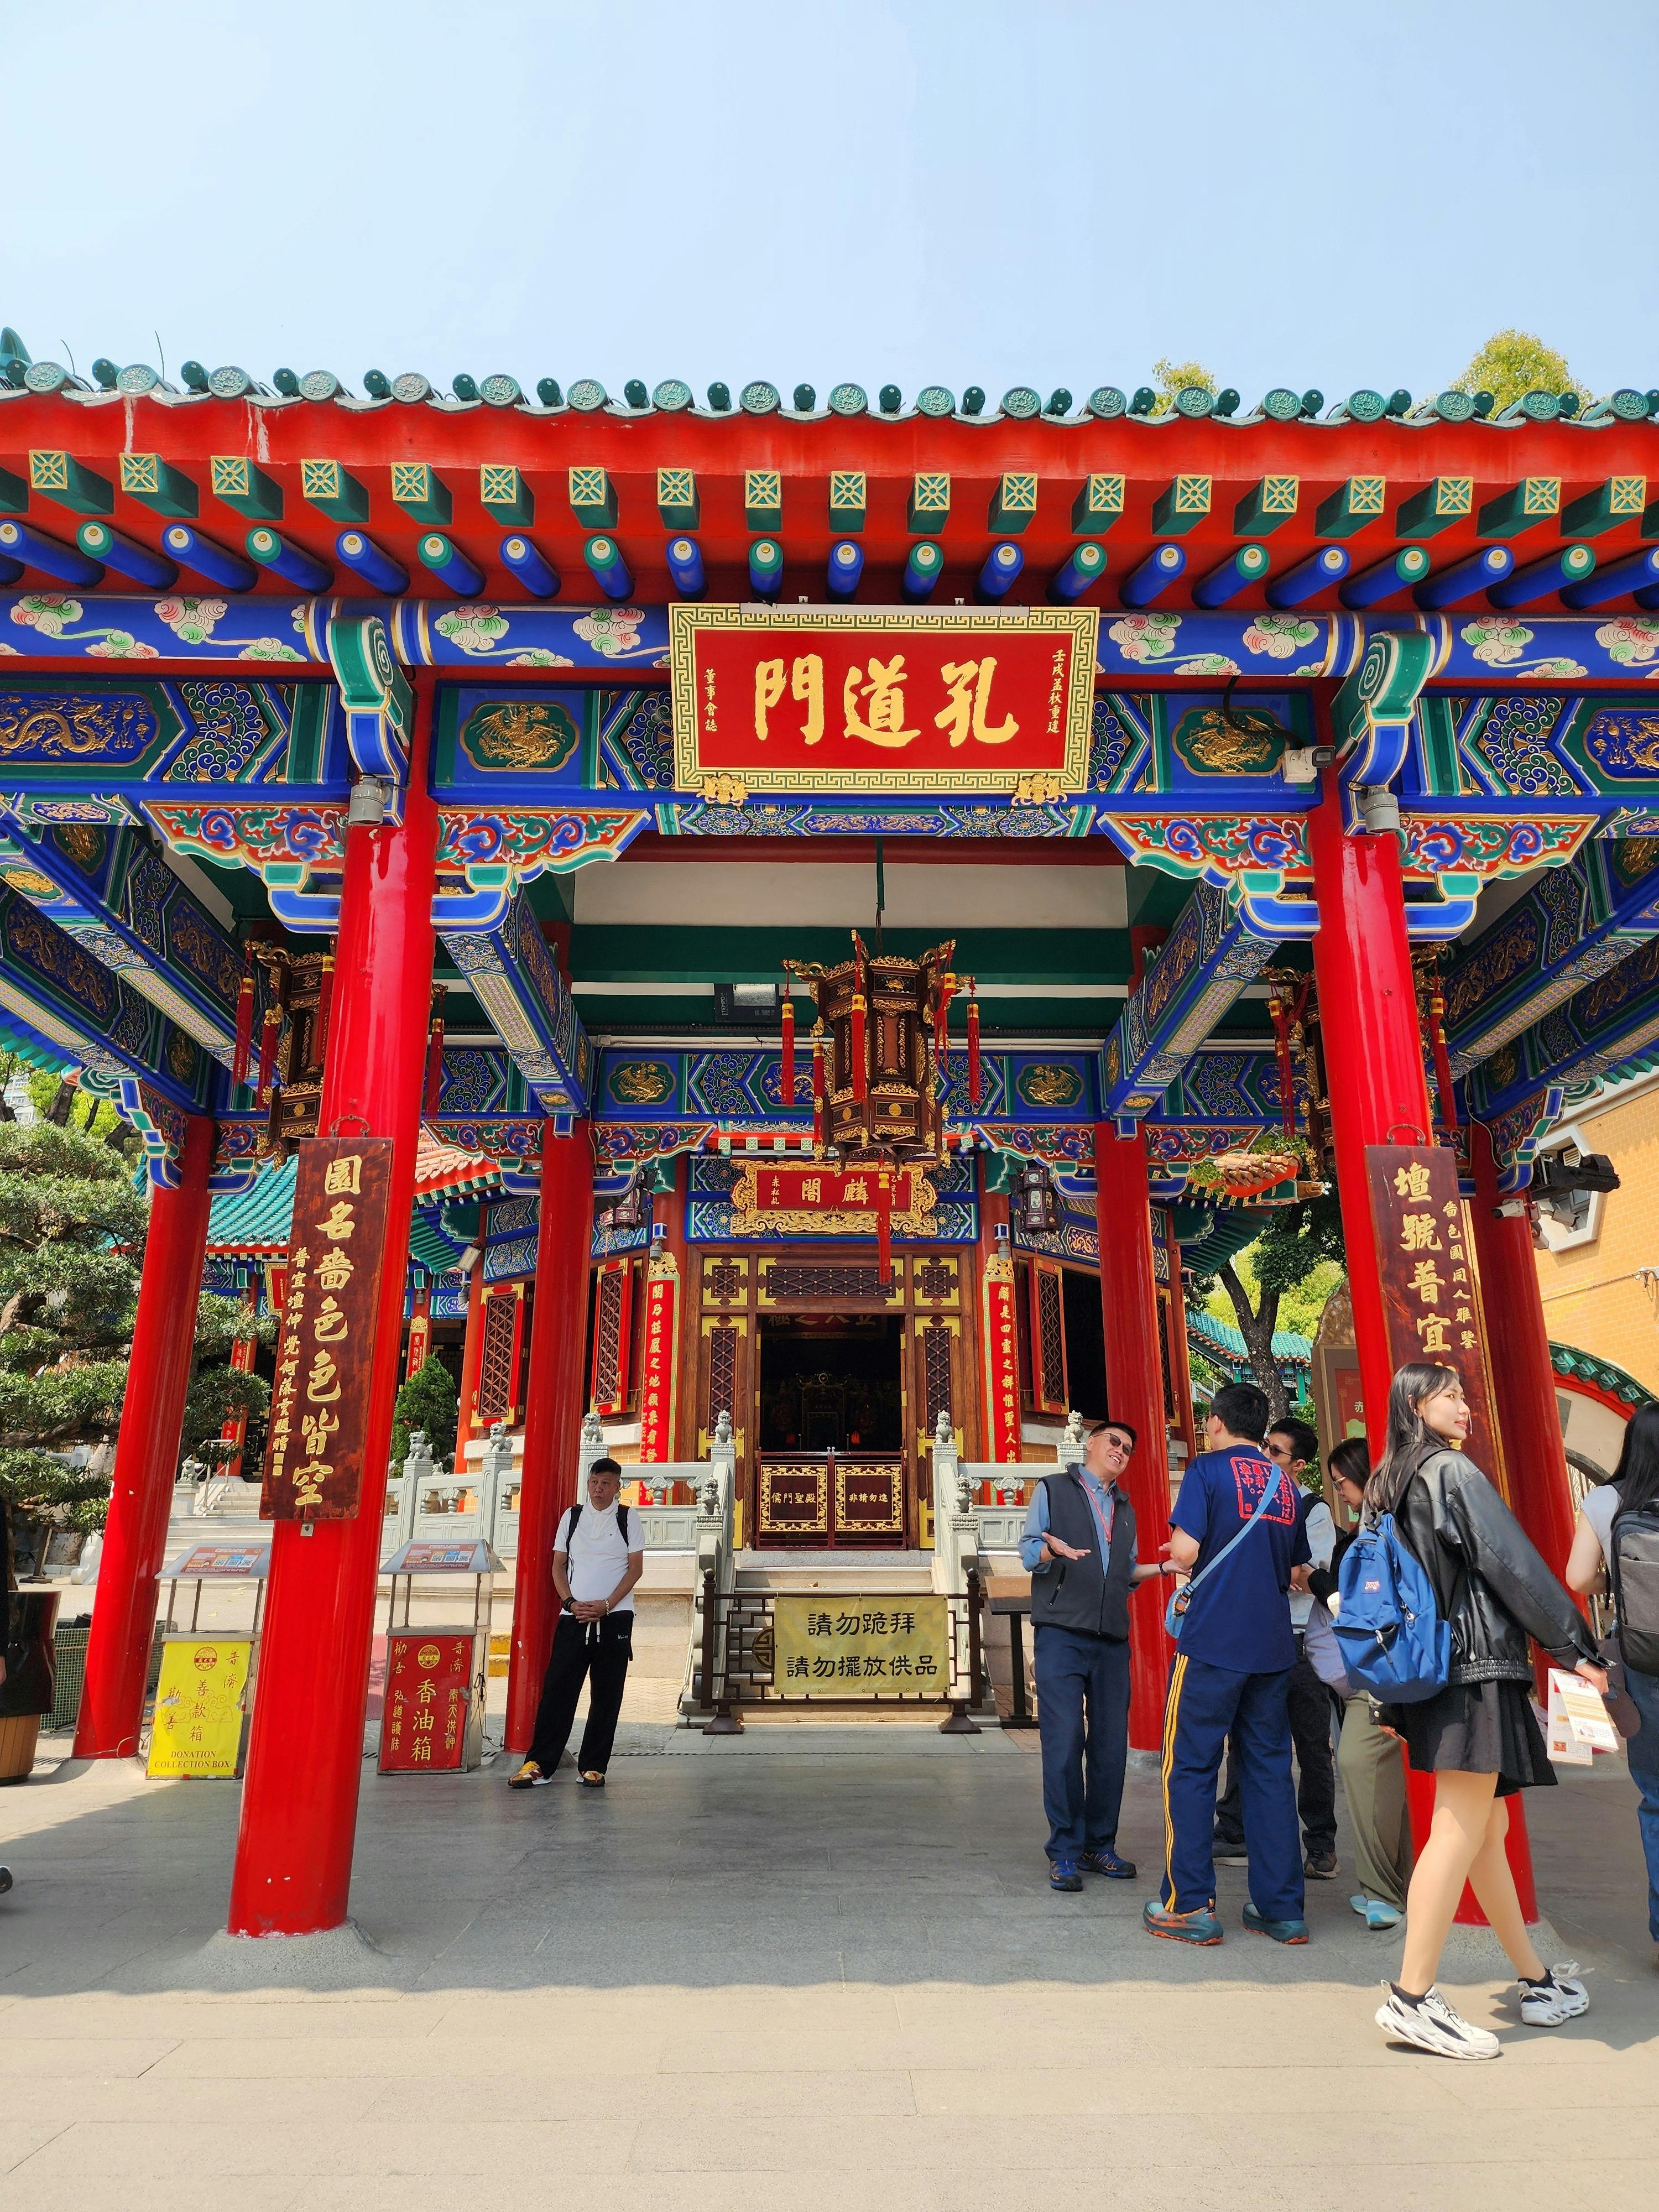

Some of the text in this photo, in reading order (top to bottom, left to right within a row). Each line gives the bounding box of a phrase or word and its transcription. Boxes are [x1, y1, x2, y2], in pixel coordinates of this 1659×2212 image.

[703, 668, 718, 732] 董事會誌
[754, 653, 1019, 748] 孔道門
[801, 1176, 869, 1205] 麟閣
[1393, 1161, 1457, 1373] 壇號普宜
[771, 1492, 816, 1504] 儒門聖殿
[848, 1493, 888, 1503] 非請勿進
[807, 1612, 916, 1636] 請勿跪拜
[223, 1649, 240, 1688] 普濟
[393, 1641, 408, 1674] 勸善
[450, 1640, 465, 1672] 普濟
[786, 1655, 938, 1678] 請勿擺放供品
[190, 1679, 209, 1742] 善款箱
[410, 1678, 436, 1762] 香油箱
